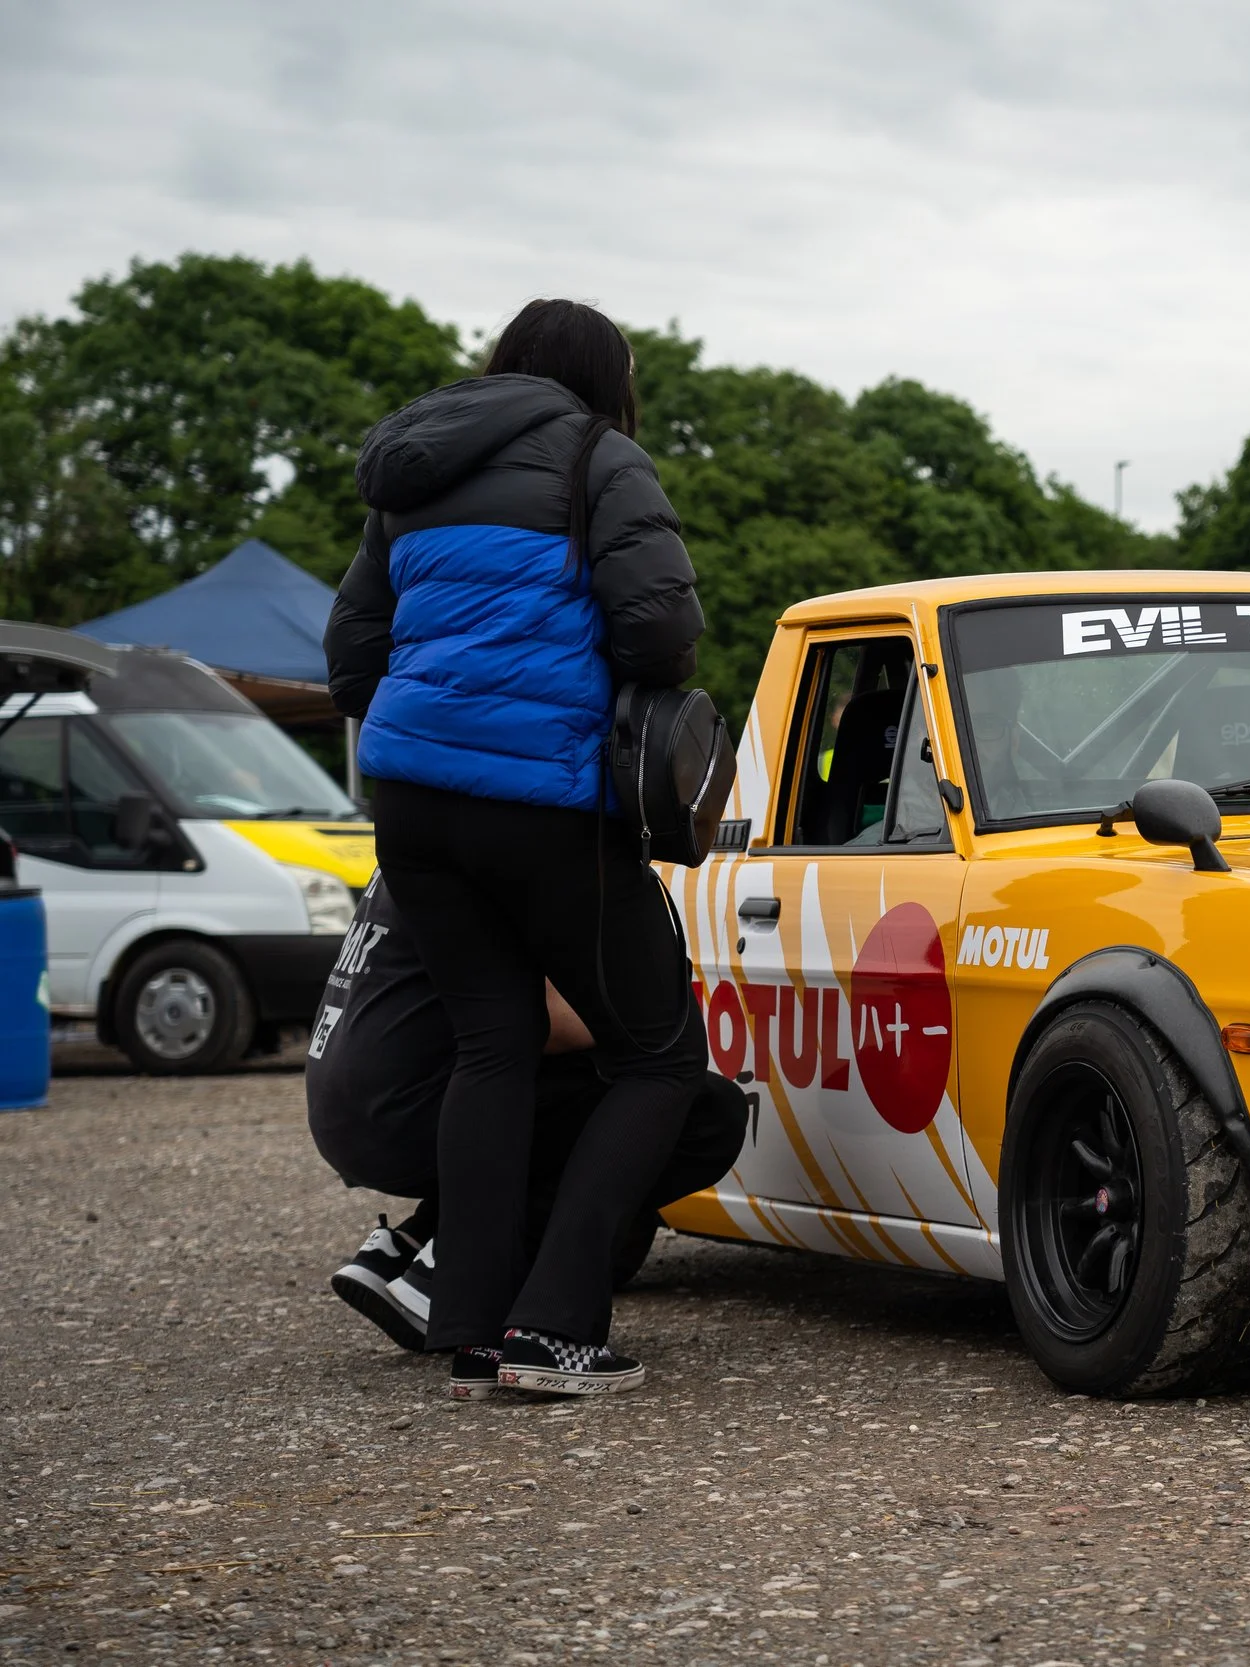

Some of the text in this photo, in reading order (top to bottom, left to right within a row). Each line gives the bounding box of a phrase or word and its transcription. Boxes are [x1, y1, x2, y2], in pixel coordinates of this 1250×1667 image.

[1062, 606, 1227, 655] EVIL
[957, 925, 1050, 970] MOTUL
[692, 980, 851, 1092] OTUL
